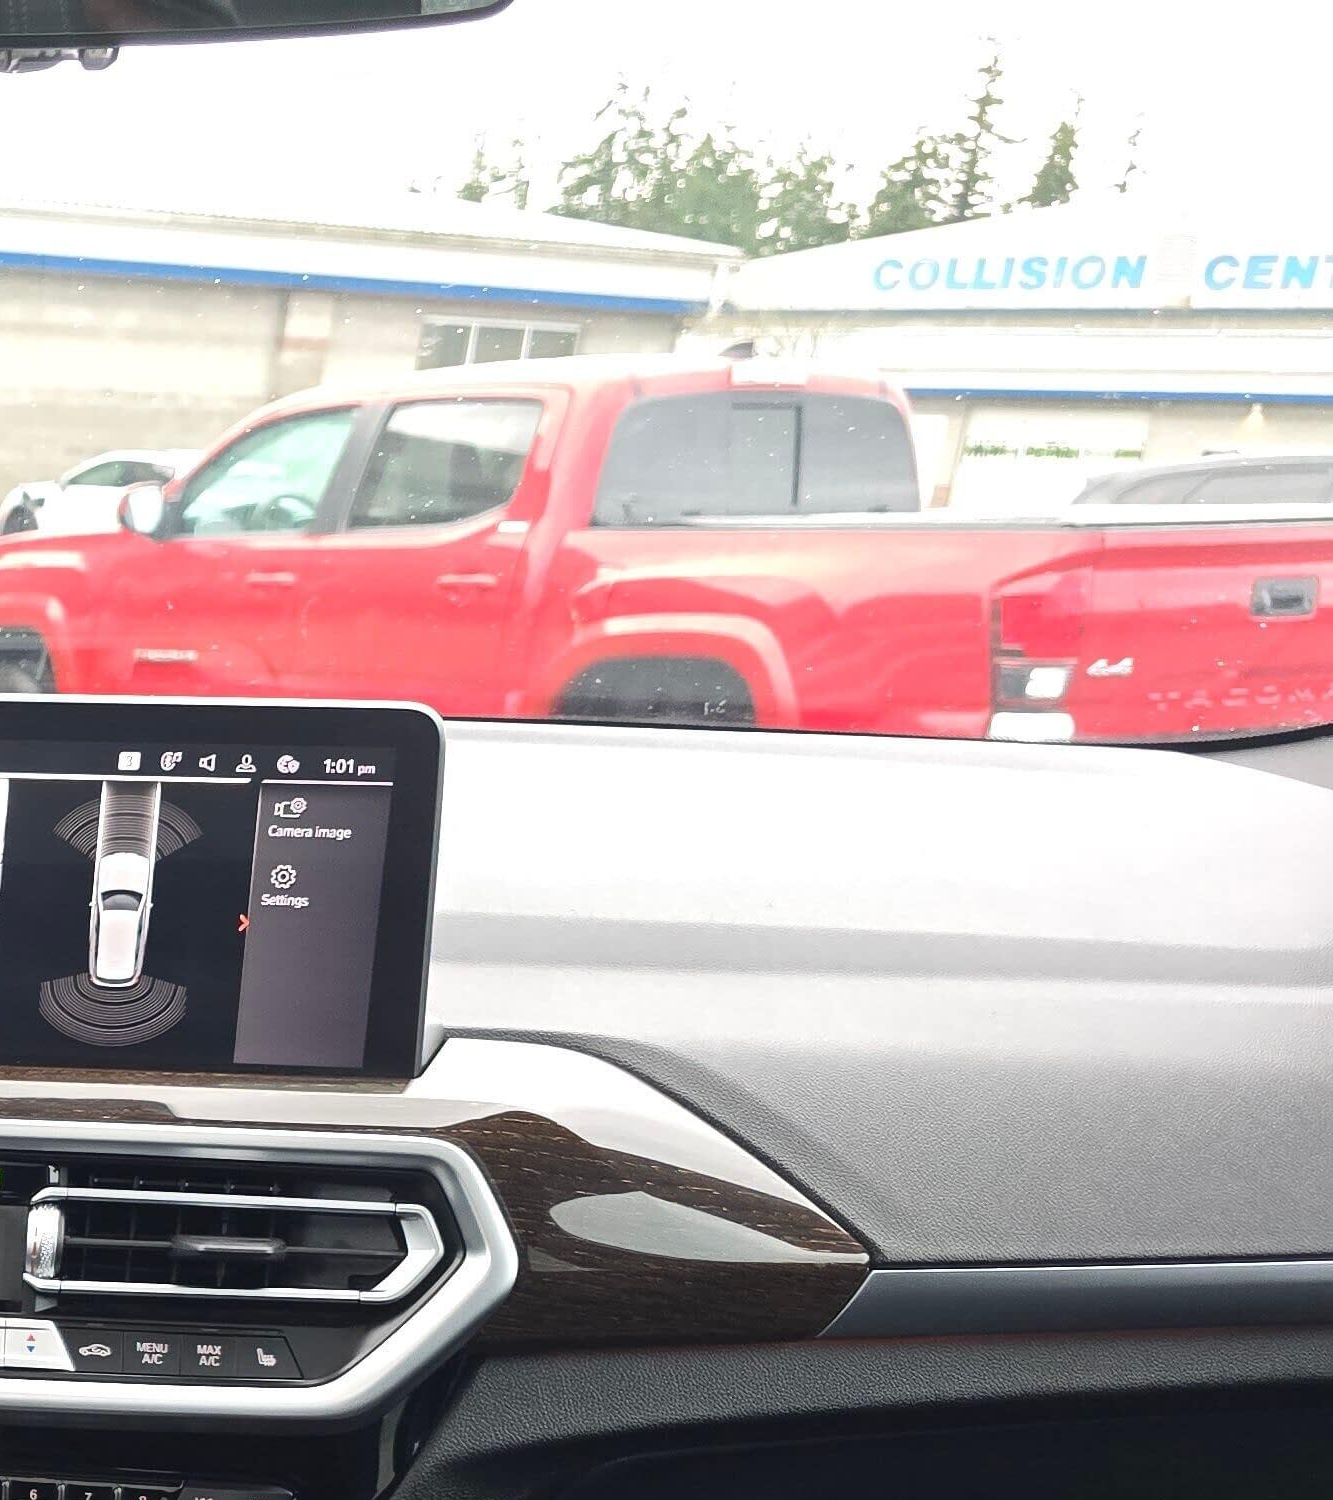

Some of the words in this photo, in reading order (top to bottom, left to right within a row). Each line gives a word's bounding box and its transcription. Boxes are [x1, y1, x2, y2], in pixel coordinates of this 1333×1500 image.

[873, 255, 1148, 292] COLLISION
[323, 757, 355, 774] 1:01
[357, 763, 376, 776] pm
[267, 824, 313, 838] Camera
[314, 825, 352, 841] image
[260, 893, 310, 908] Settings
[136, 1341, 169, 1354] MENU
[196, 1343, 222, 1355] MAX
[141, 1353, 163, 1366] A/C
[198, 1354, 221, 1367] A/C
[29, 1488, 38, 1500] 6
